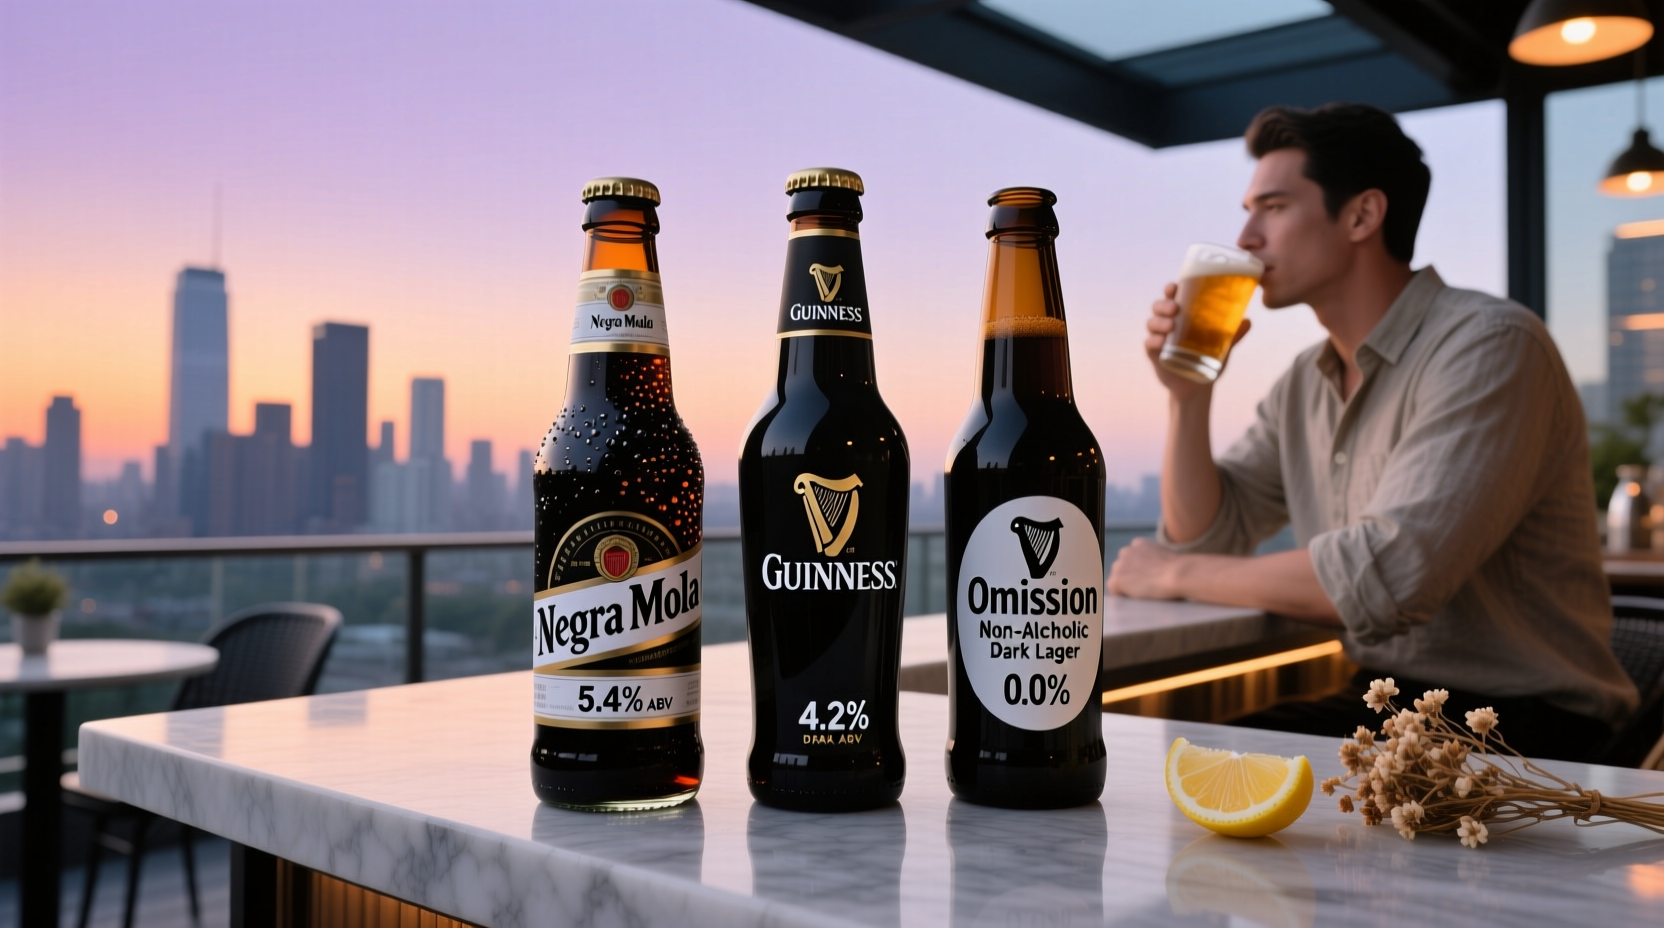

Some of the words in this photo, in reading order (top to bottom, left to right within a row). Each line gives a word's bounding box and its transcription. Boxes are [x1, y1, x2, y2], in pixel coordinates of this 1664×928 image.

[790, 303, 862, 322] GUINNESS
[762, 553, 896, 590] GUINNESS
[968, 576, 1097, 615] Omission
[537, 604, 624, 656] Negra
[629, 569, 699, 630] Mola
[979, 619, 1089, 639] Non-Alcholic
[990, 642, 1030, 659] Dark
[1035, 643, 1080, 664] Lager
[578, 685, 643, 713] 5.4%
[646, 696, 673, 712] ABV
[1004, 673, 1070, 706] 0.0%
[798, 699, 869, 731] 4.2%
